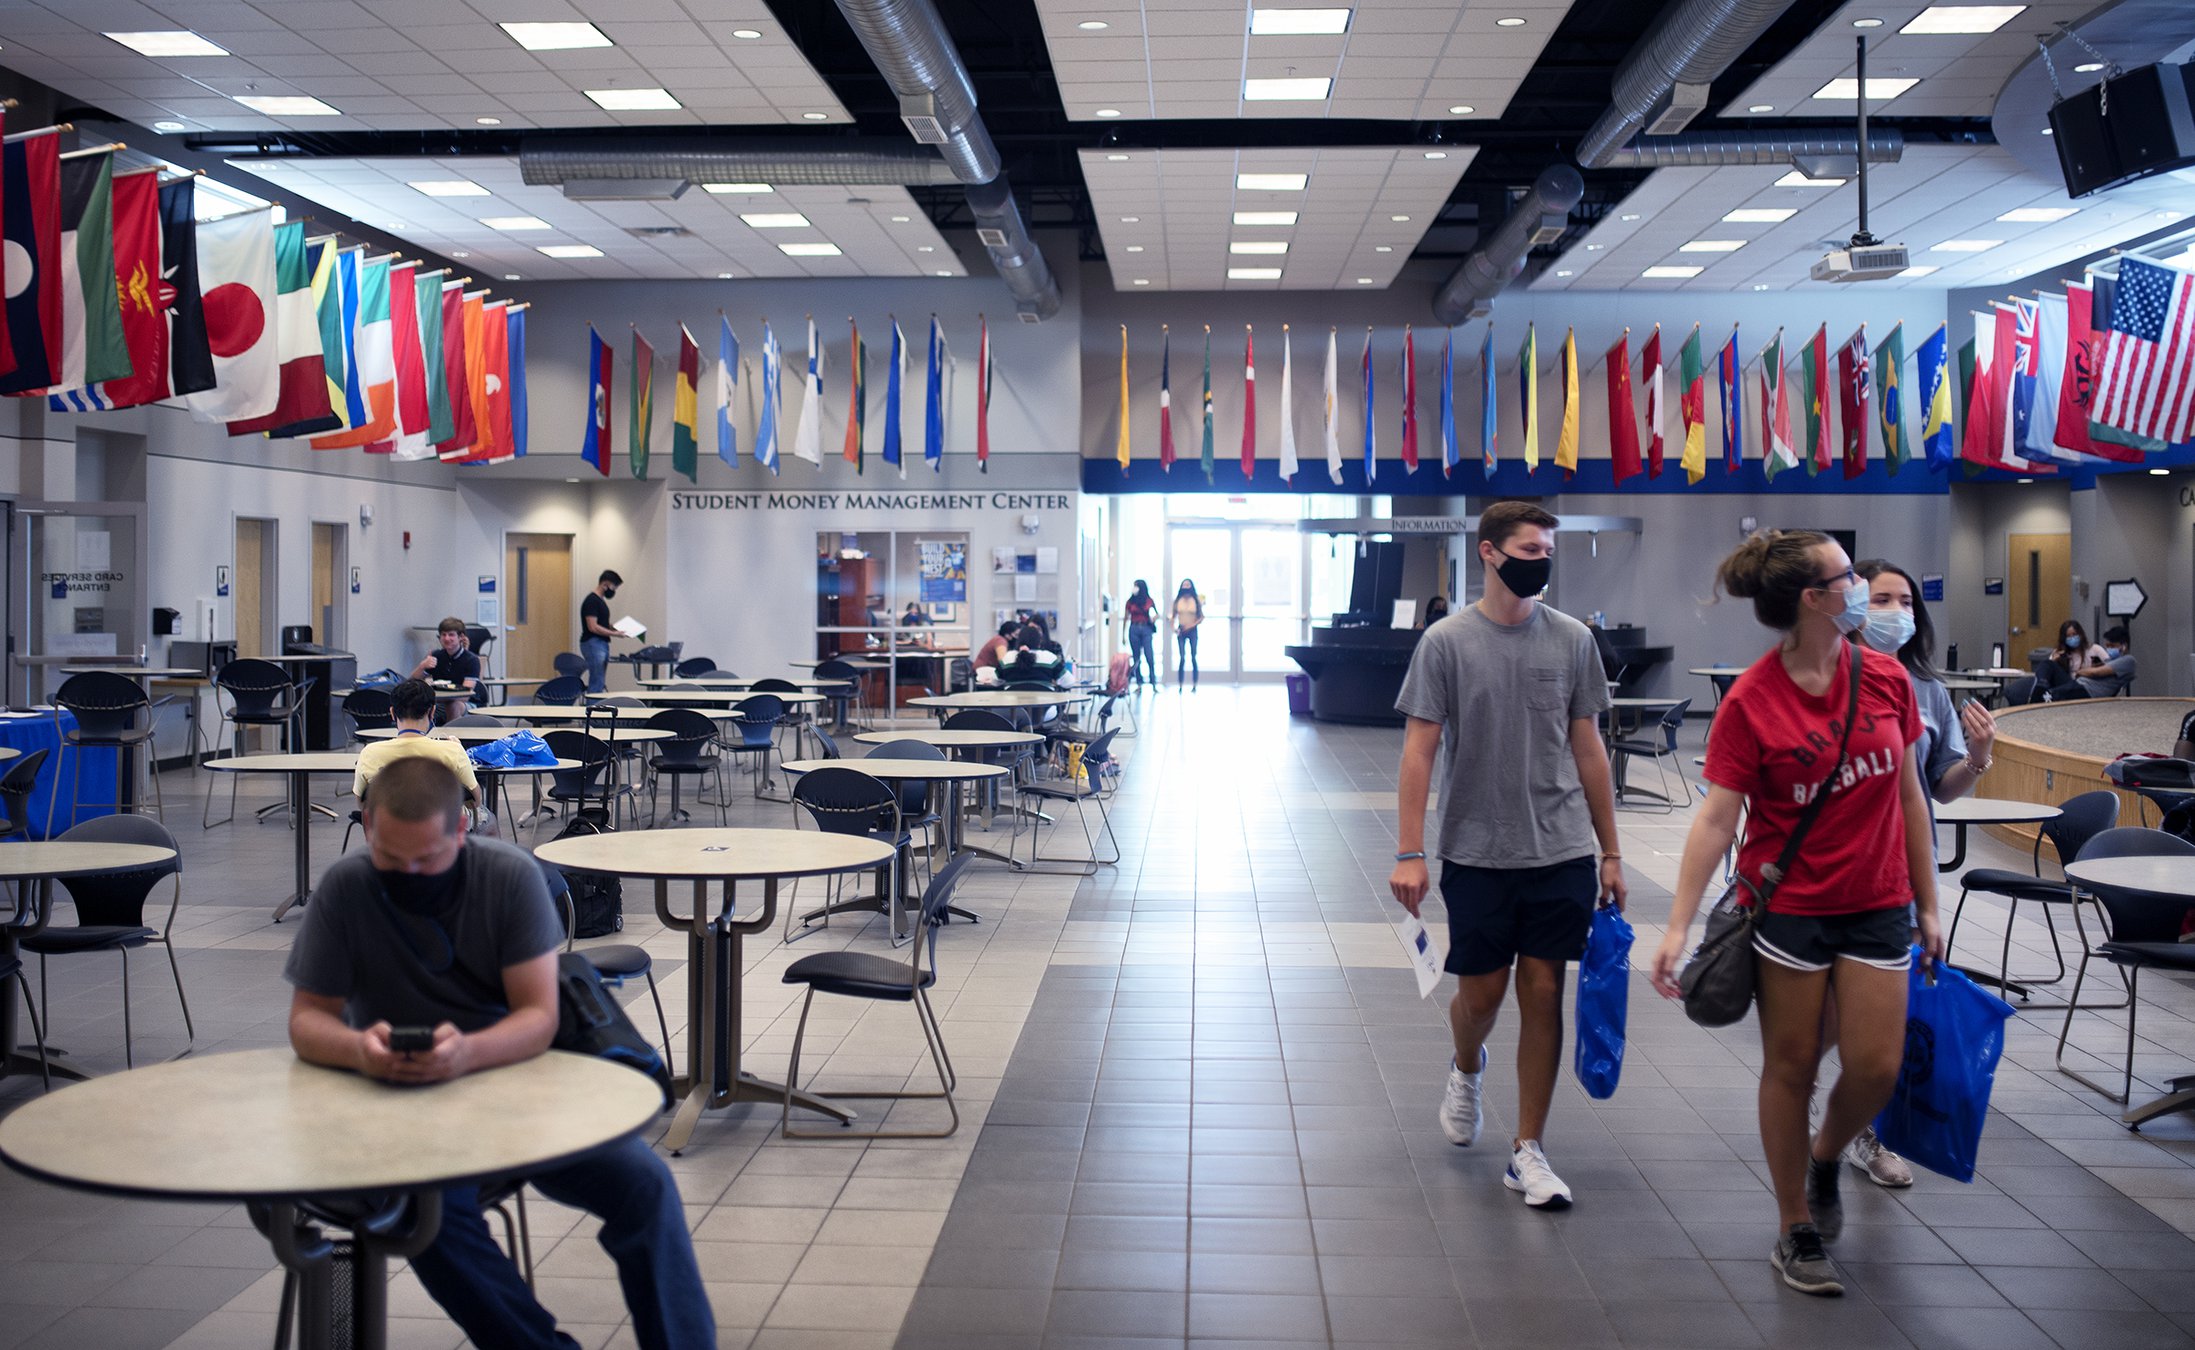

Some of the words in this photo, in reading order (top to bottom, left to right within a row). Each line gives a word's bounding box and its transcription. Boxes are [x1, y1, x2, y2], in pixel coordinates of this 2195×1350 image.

[672, 492, 761, 510] STUDENT
[767, 493, 840, 510] MONEY
[845, 493, 986, 510] MANAGEMENT
[992, 492, 1070, 510] CENTER
[1392, 519, 1467, 531] INFORMATION
[1793, 747, 1896, 805] BABALL
